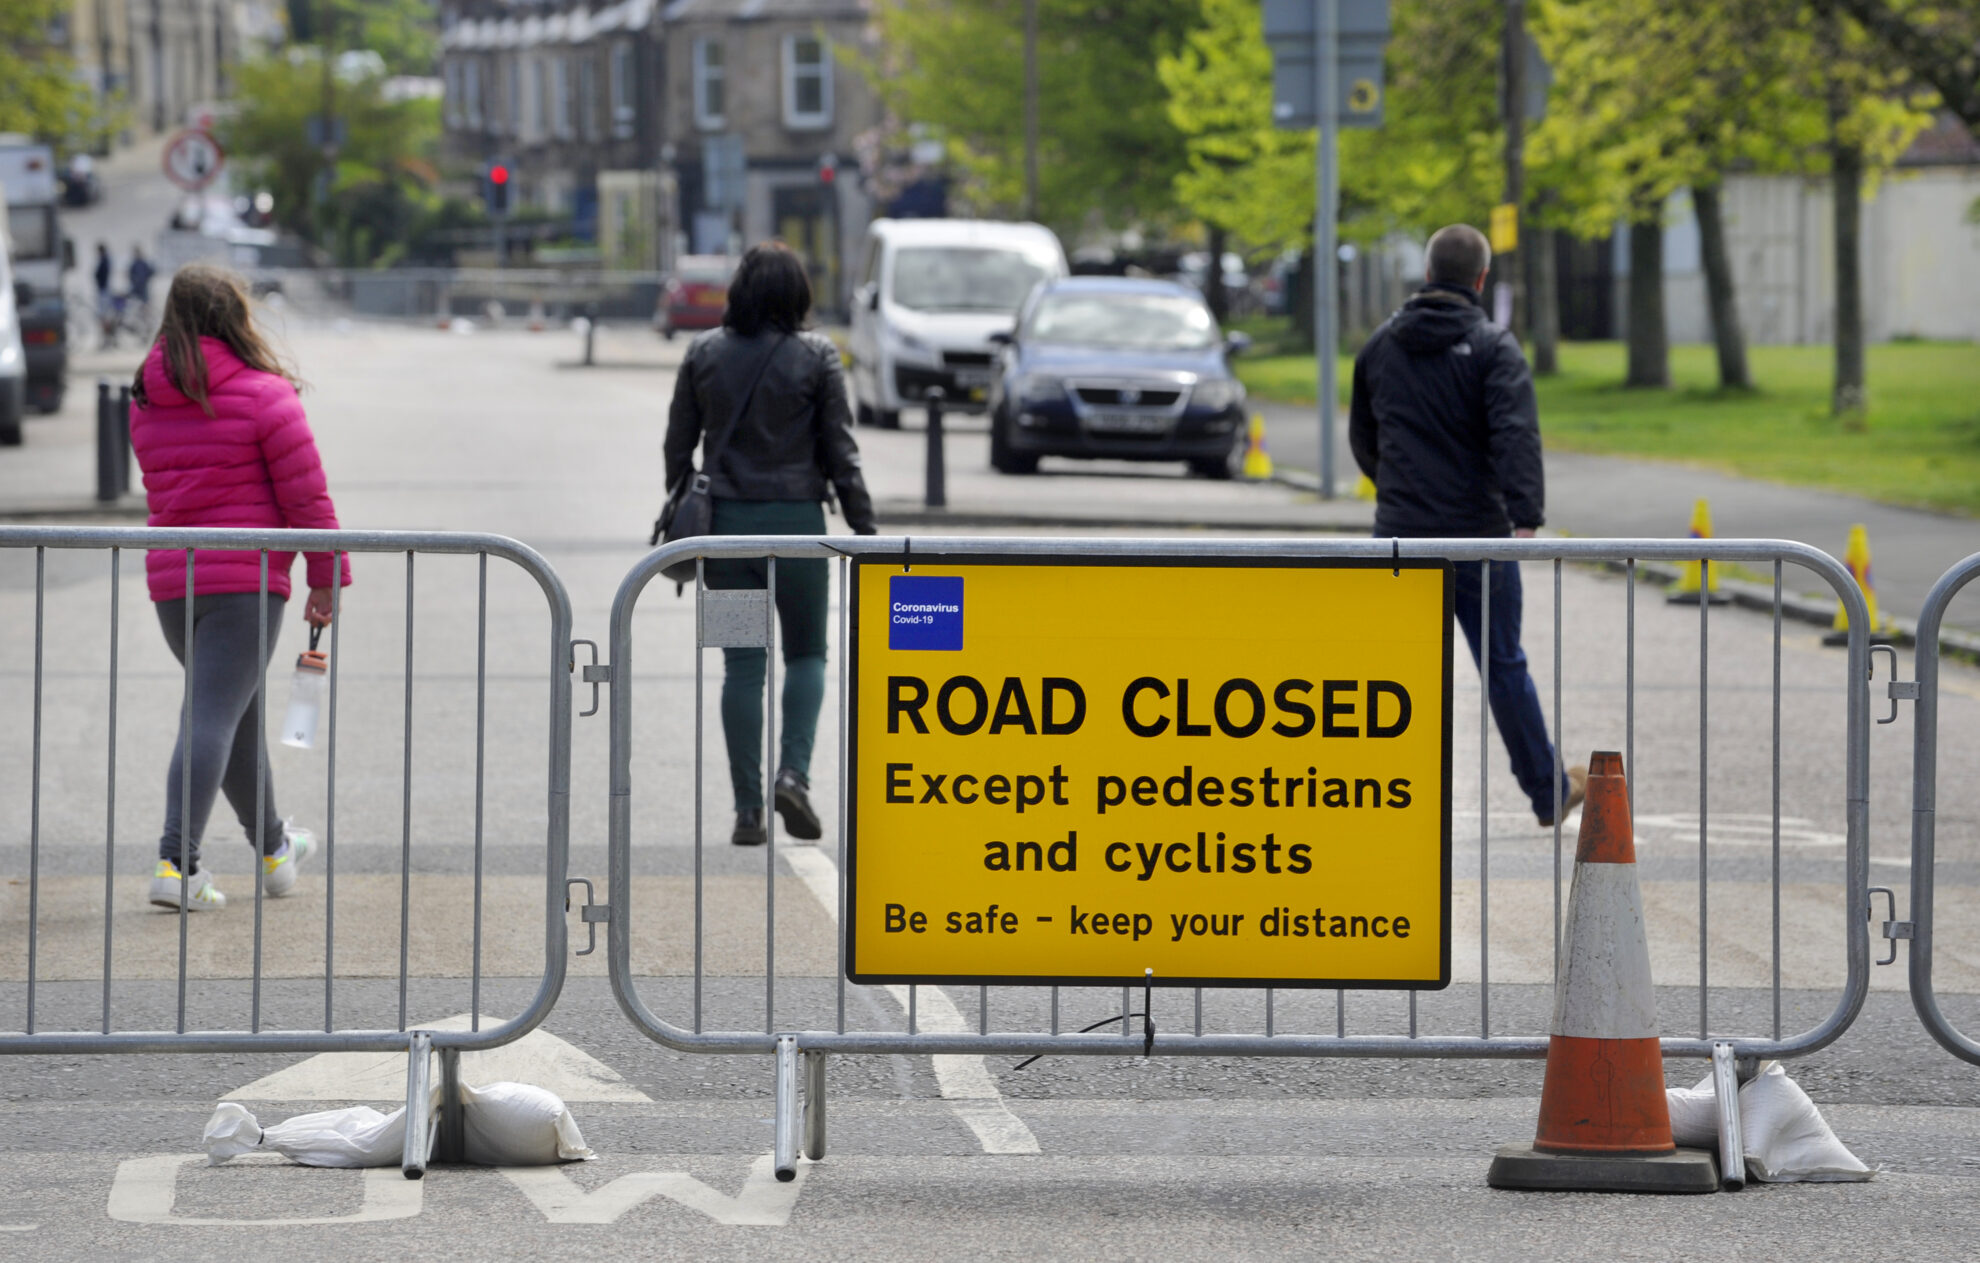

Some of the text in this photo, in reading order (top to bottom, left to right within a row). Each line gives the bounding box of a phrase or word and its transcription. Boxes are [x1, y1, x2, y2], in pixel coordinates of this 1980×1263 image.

[893, 602, 959, 613] Coronavirus
[893, 614, 934, 624] Covid-19
[887, 675, 1412, 739] ROAD CLOSED
[885, 762, 1412, 815] Except pedestrians
[983, 830, 1313, 882] and cyclists
[884, 903, 928, 934] Be
[945, 904, 1019, 935] safe
[1070, 904, 1153, 942] keep
[1170, 913, 1245, 942] your
[1259, 906, 1411, 939] distance
